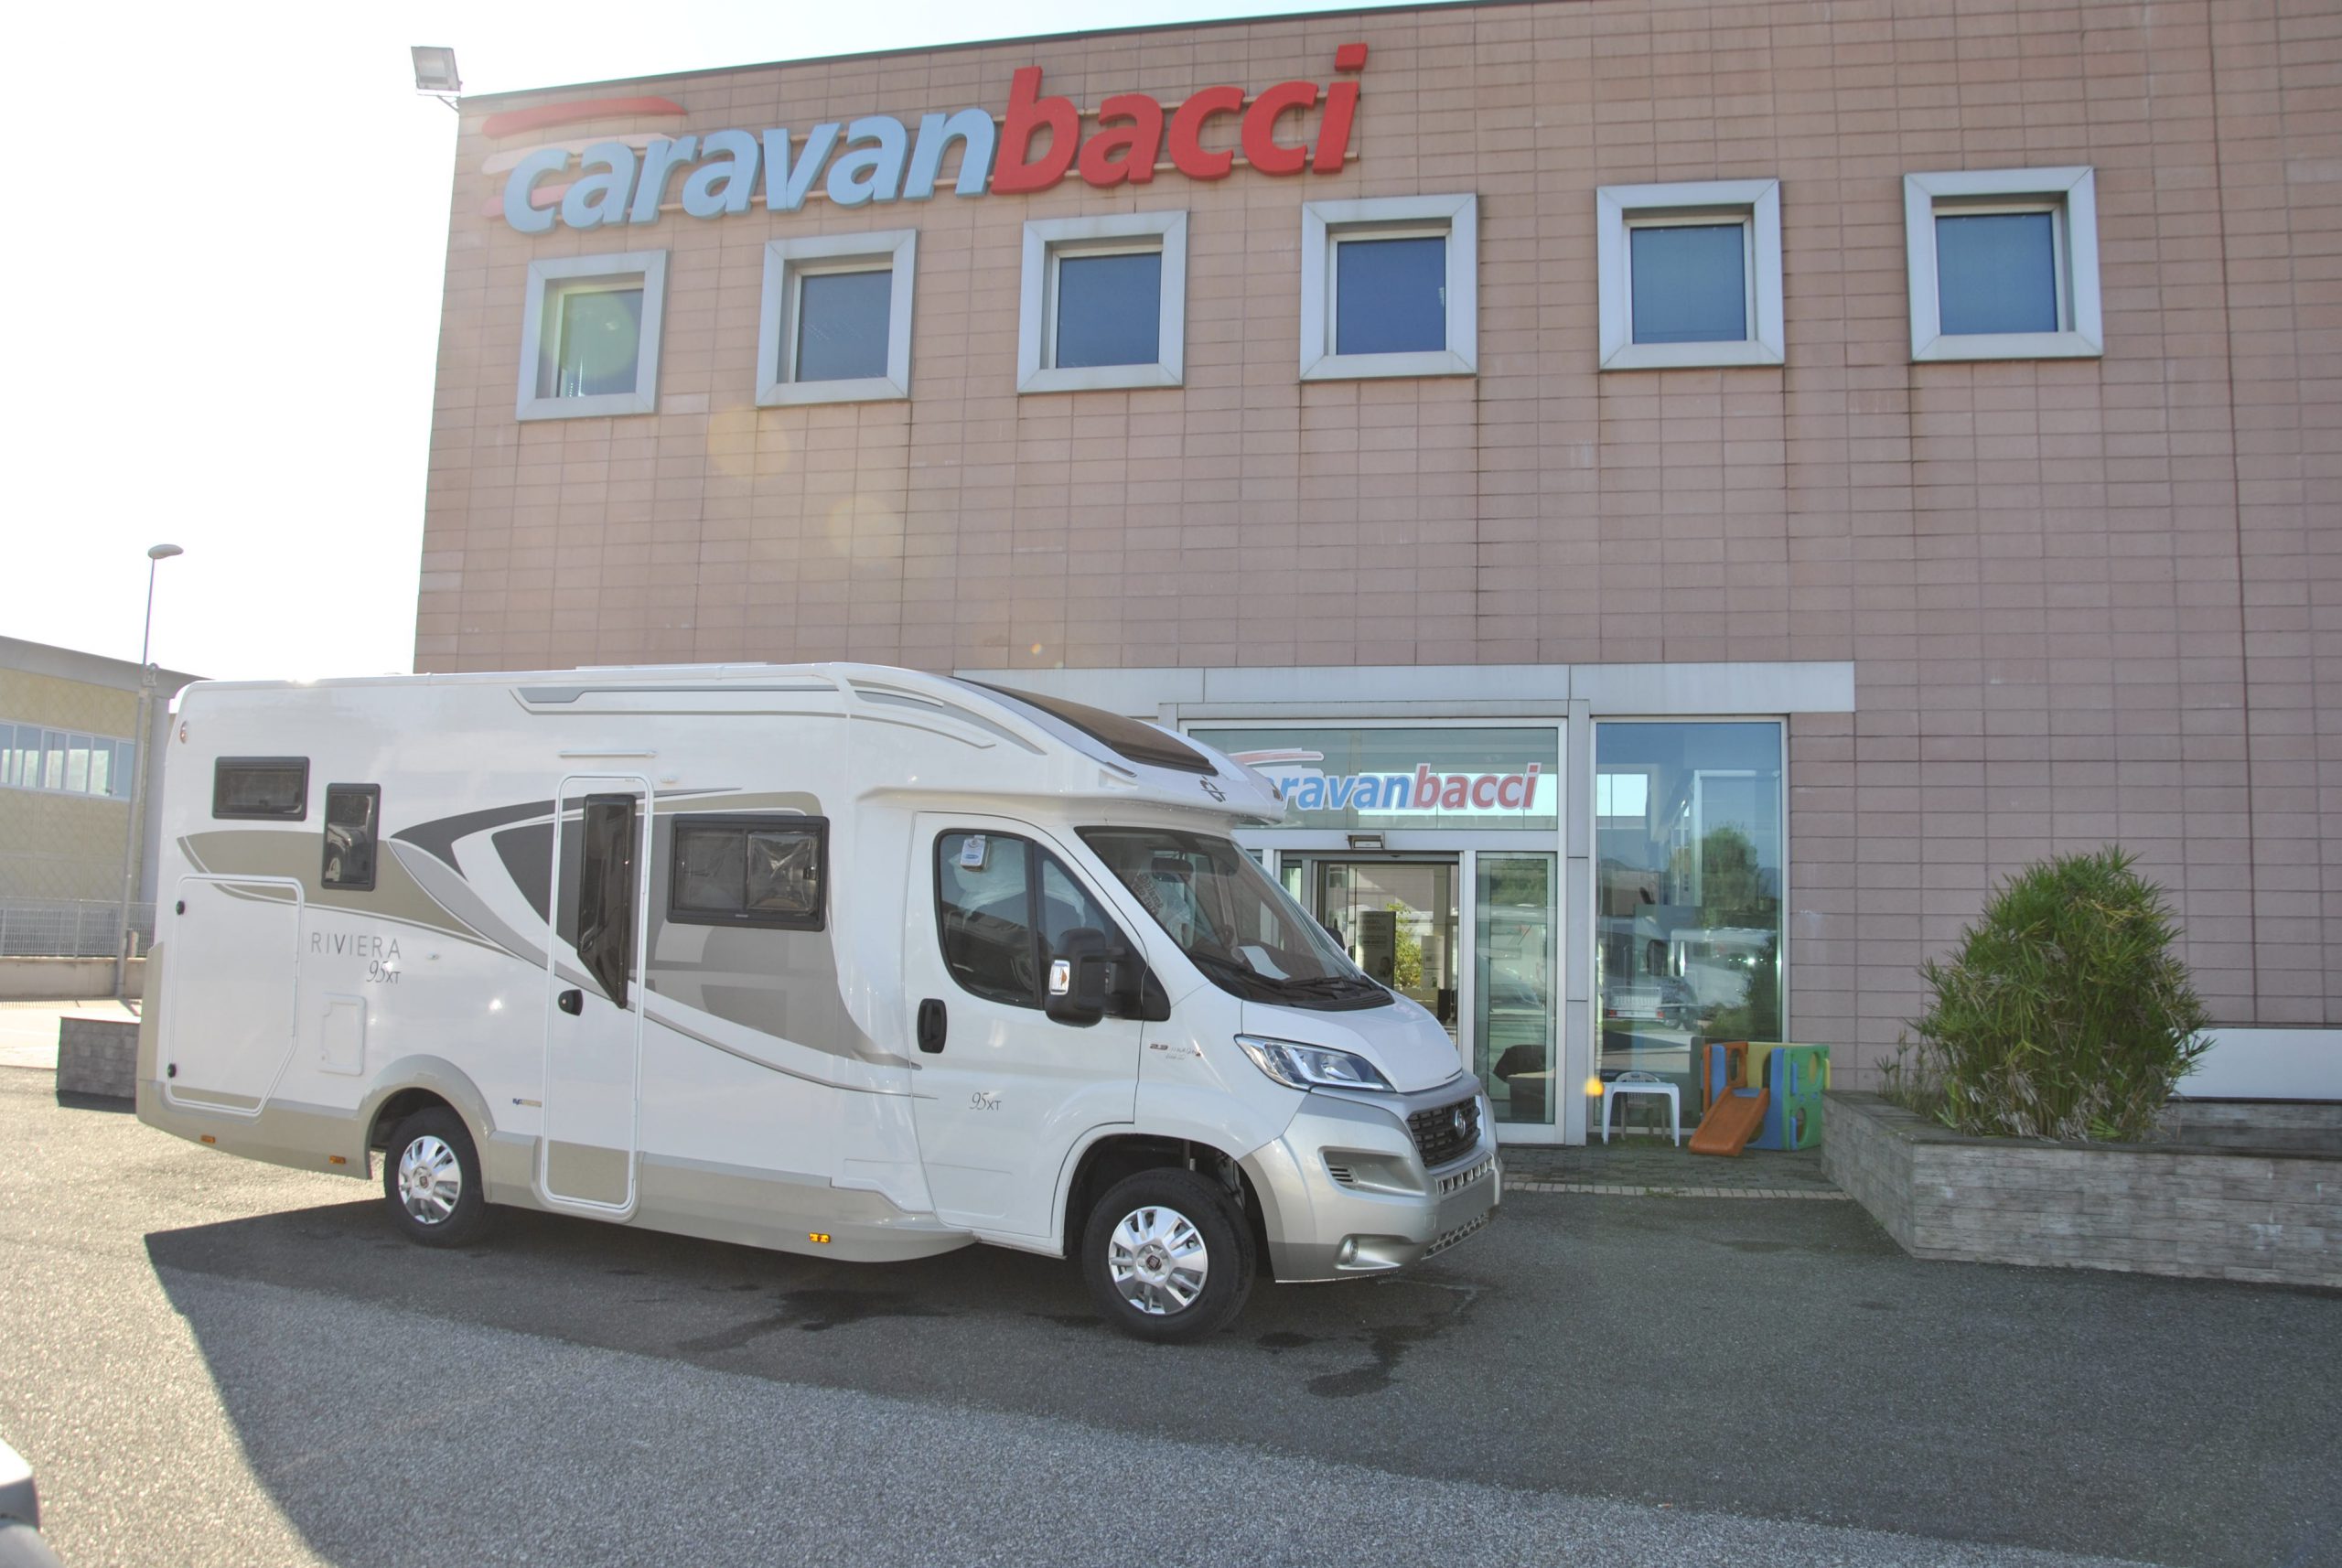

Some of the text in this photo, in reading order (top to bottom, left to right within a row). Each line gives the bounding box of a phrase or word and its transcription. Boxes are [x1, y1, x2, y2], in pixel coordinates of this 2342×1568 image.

[503, 43, 1368, 235] caravanbacci
[1268, 763, 1542, 811] ravanbacci
[311, 931, 401, 960] RIVIERA
[969, 1091, 1003, 1112] 95XT
